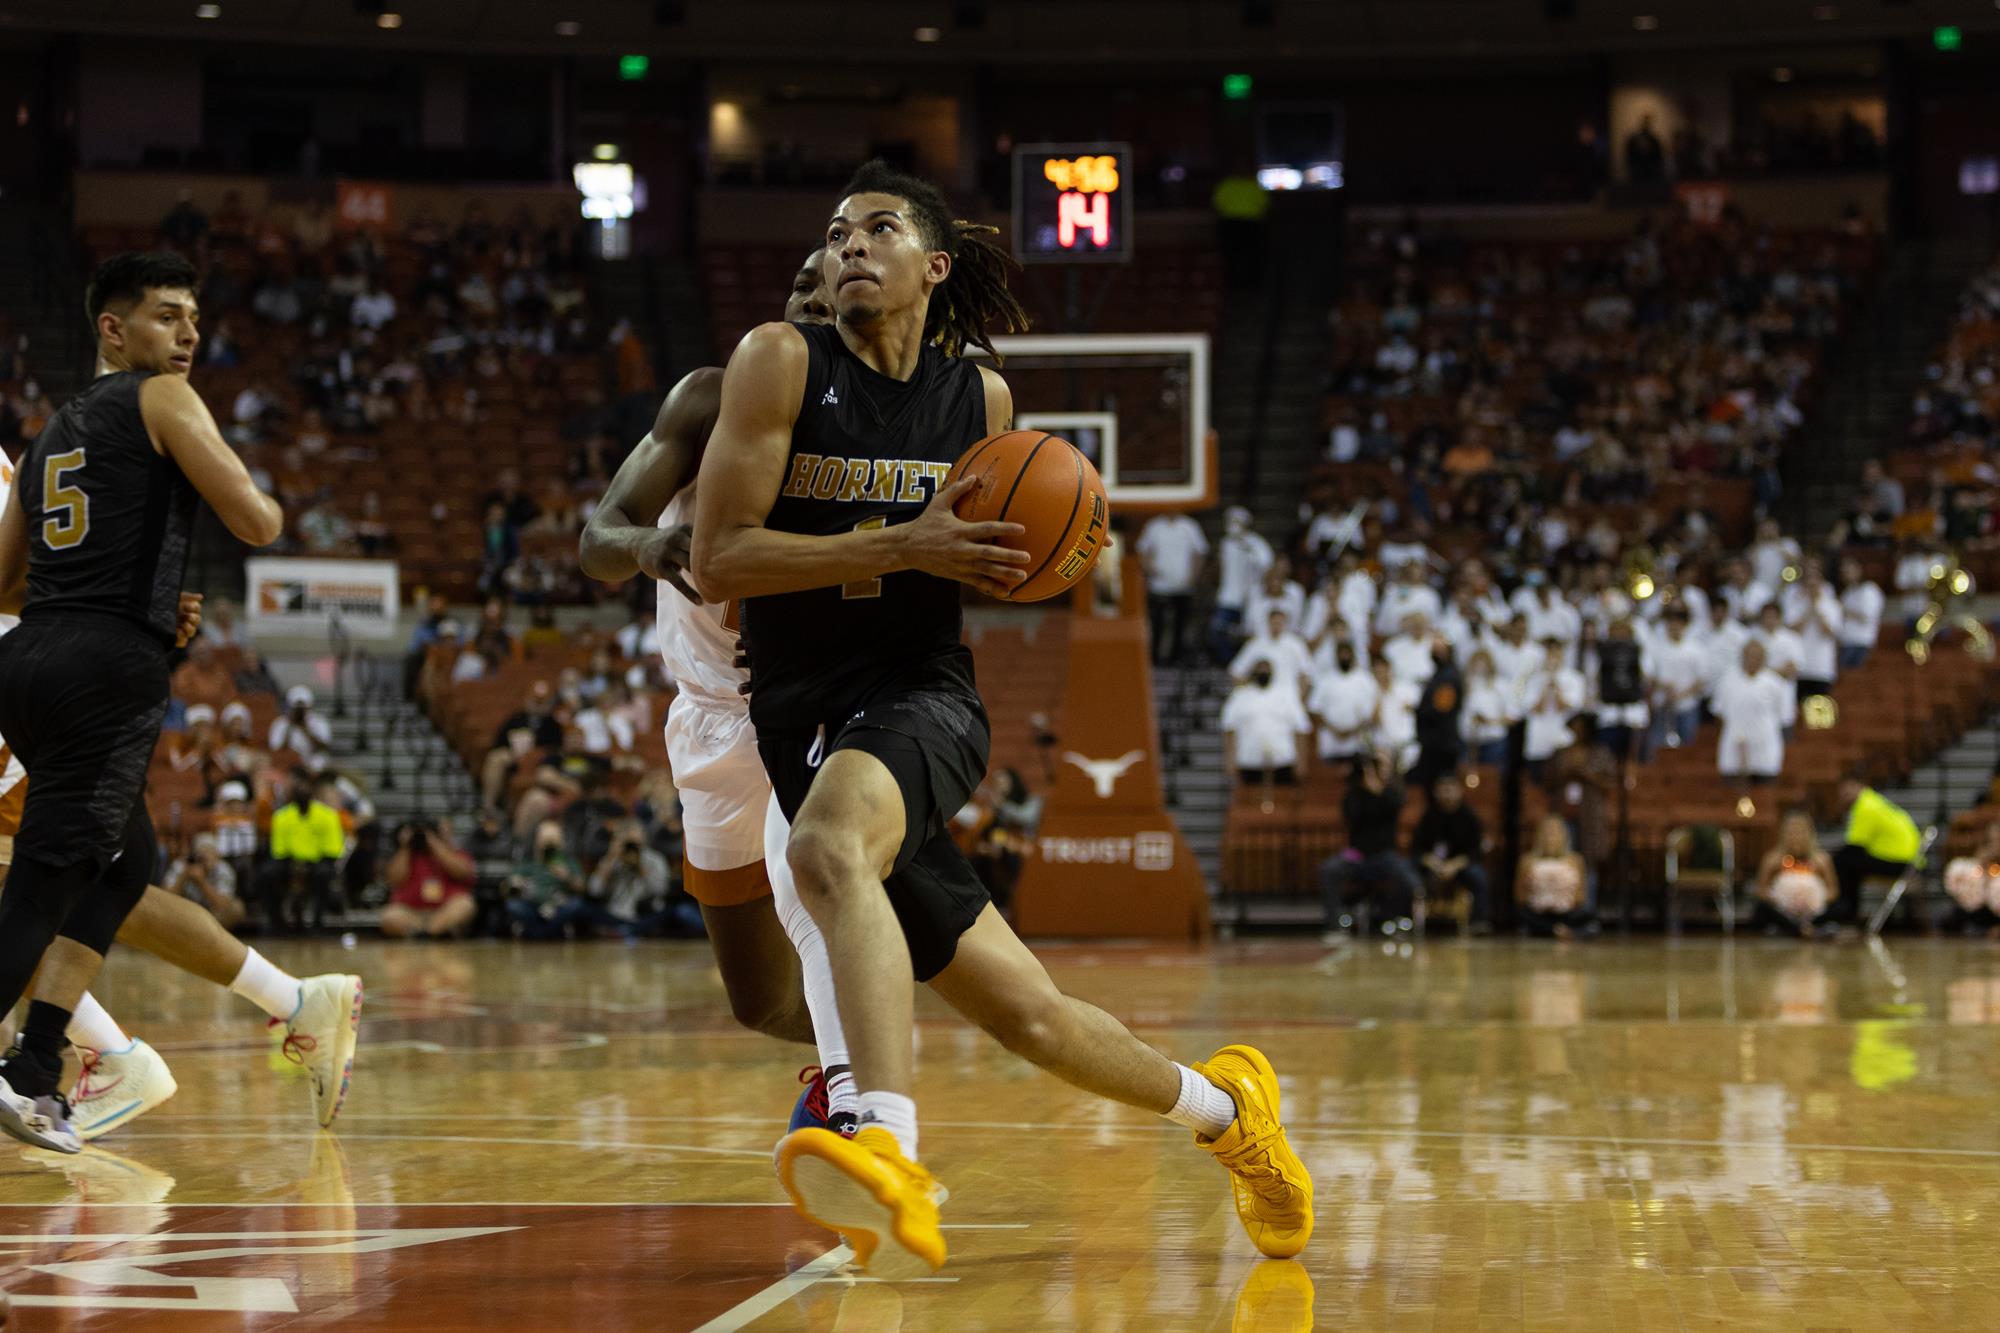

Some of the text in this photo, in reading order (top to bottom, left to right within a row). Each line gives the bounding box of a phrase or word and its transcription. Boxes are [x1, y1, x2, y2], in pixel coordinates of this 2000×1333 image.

[1058, 191, 1110, 248] 14
[42, 447, 90, 551] 5
[782, 453, 953, 503] HORNET
[1054, 490, 1096, 573] CIONSHIP
